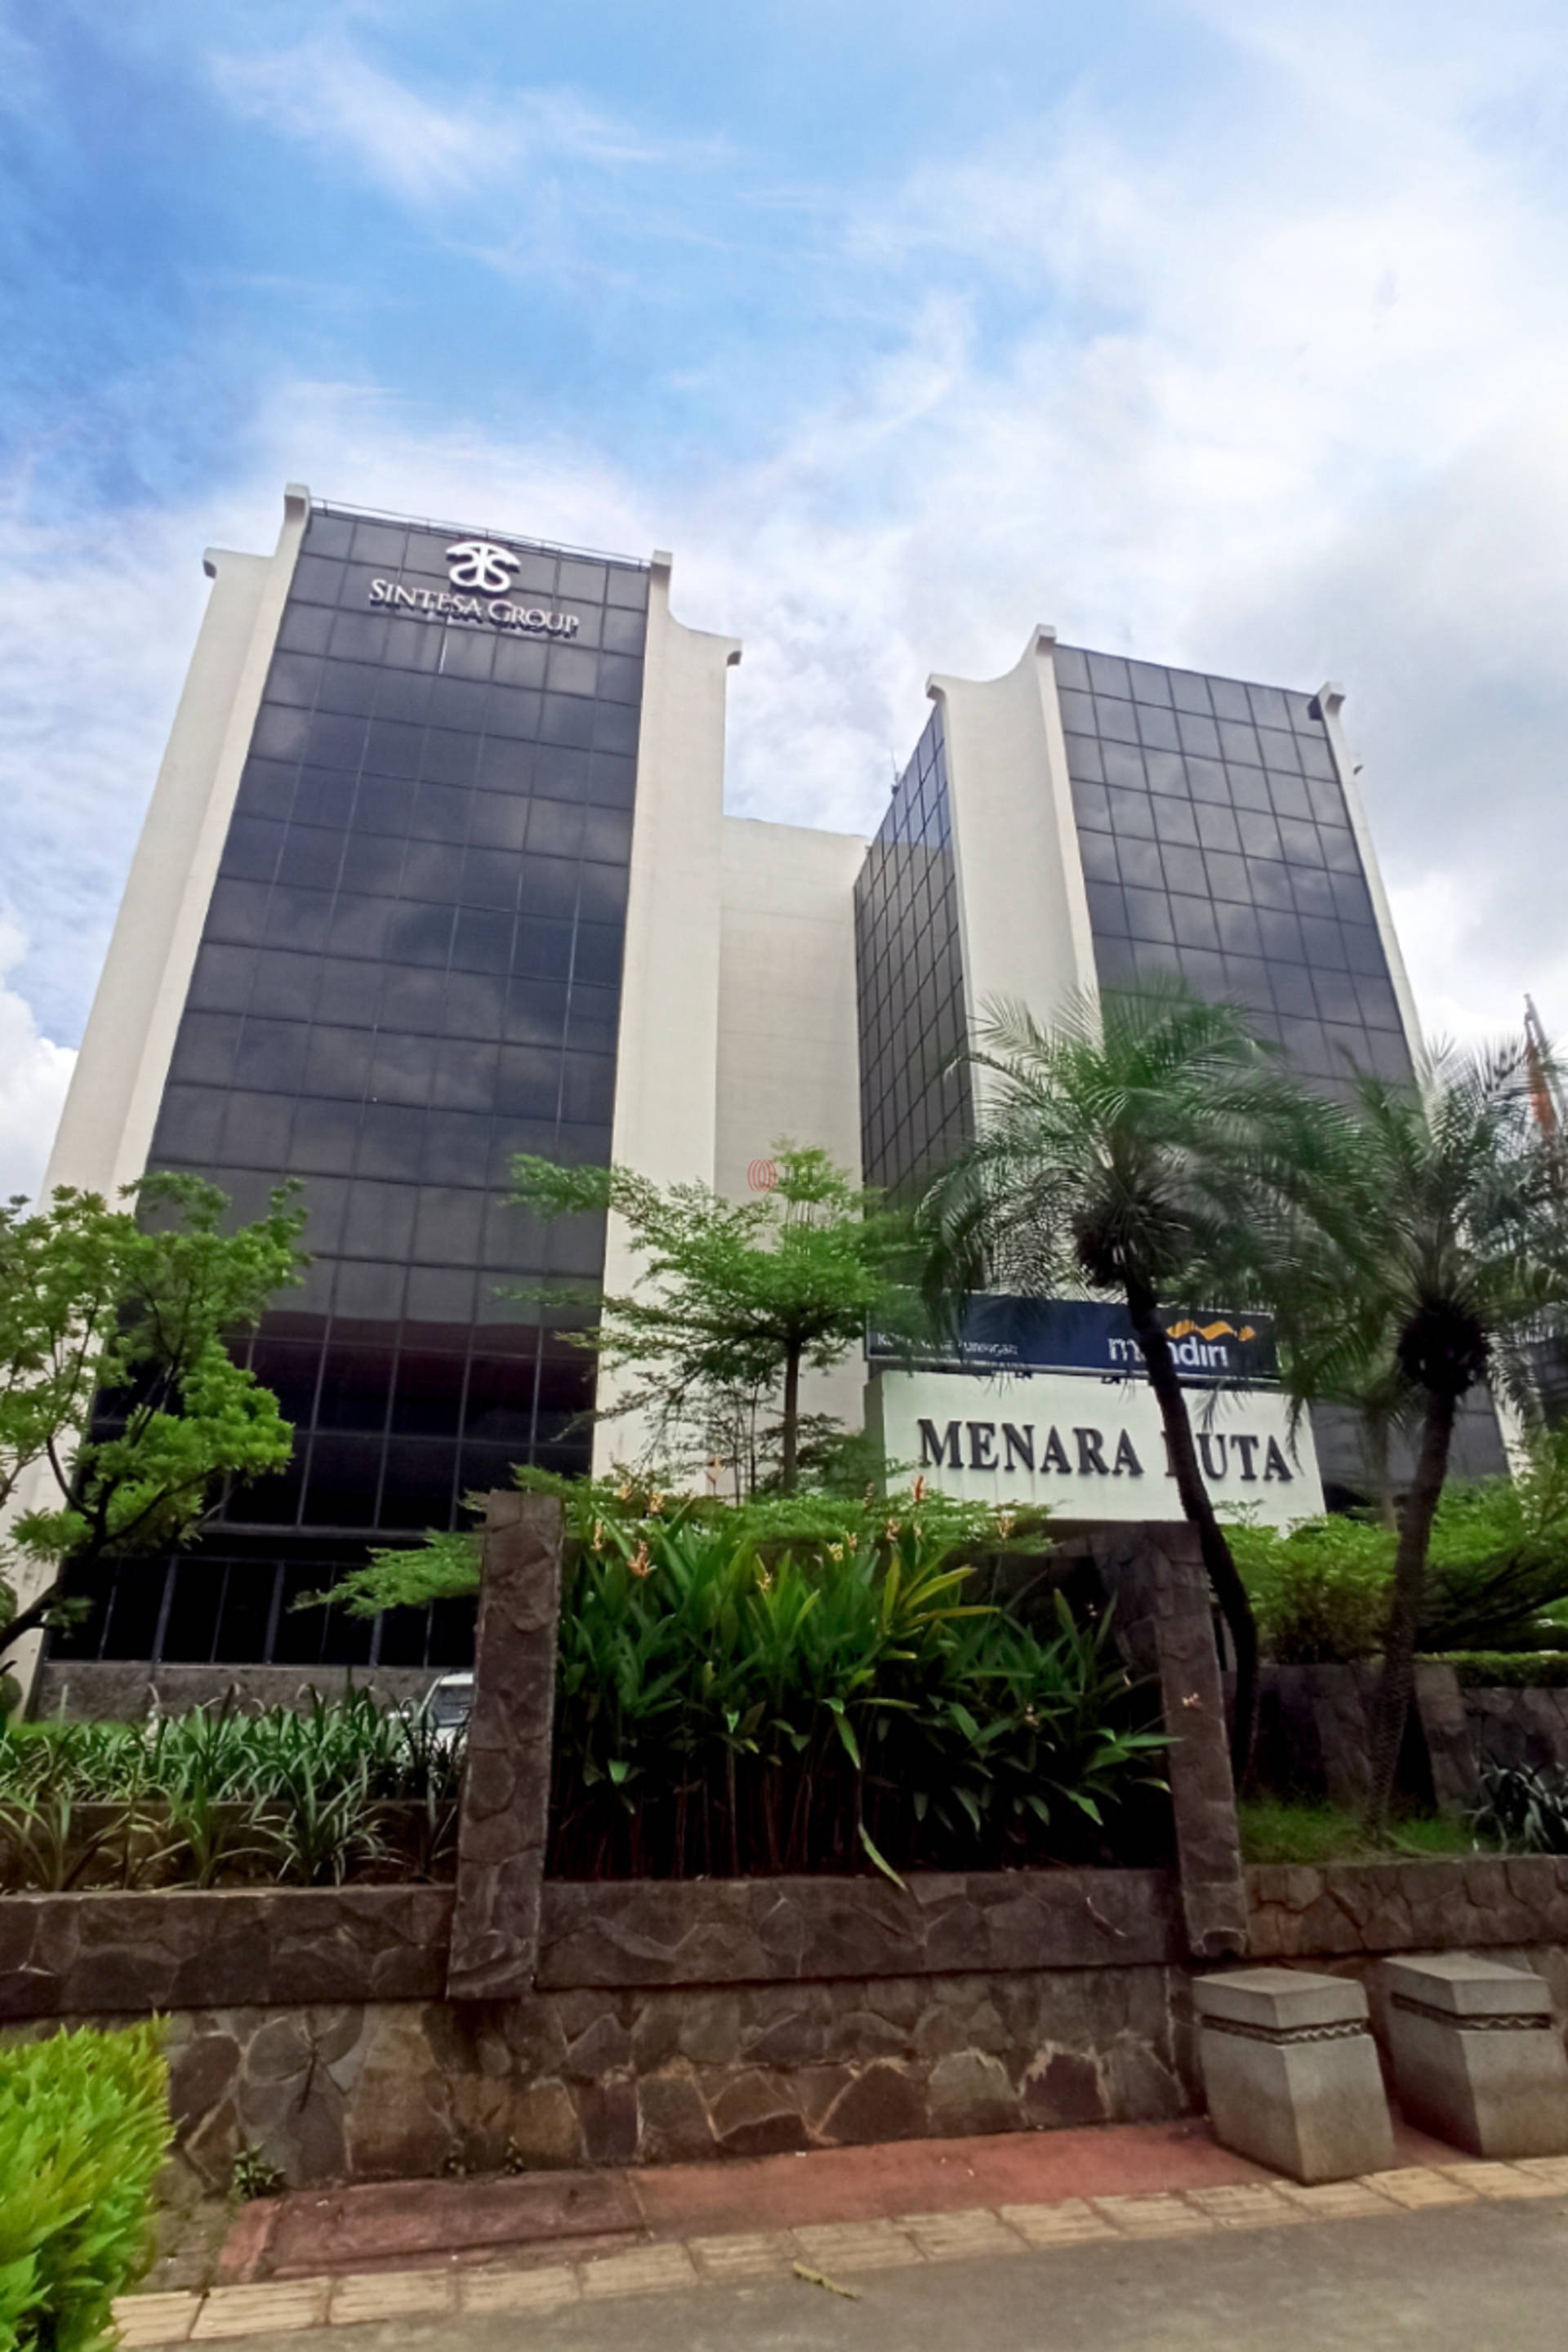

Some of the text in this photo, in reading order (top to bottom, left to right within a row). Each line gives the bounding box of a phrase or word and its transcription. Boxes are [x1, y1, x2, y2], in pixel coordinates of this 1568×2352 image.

[369, 578, 579, 632] SINTESA GROUP
[1107, 1336, 1228, 1367] mndiri
[917, 1419, 1294, 1482] MENARA UTA
